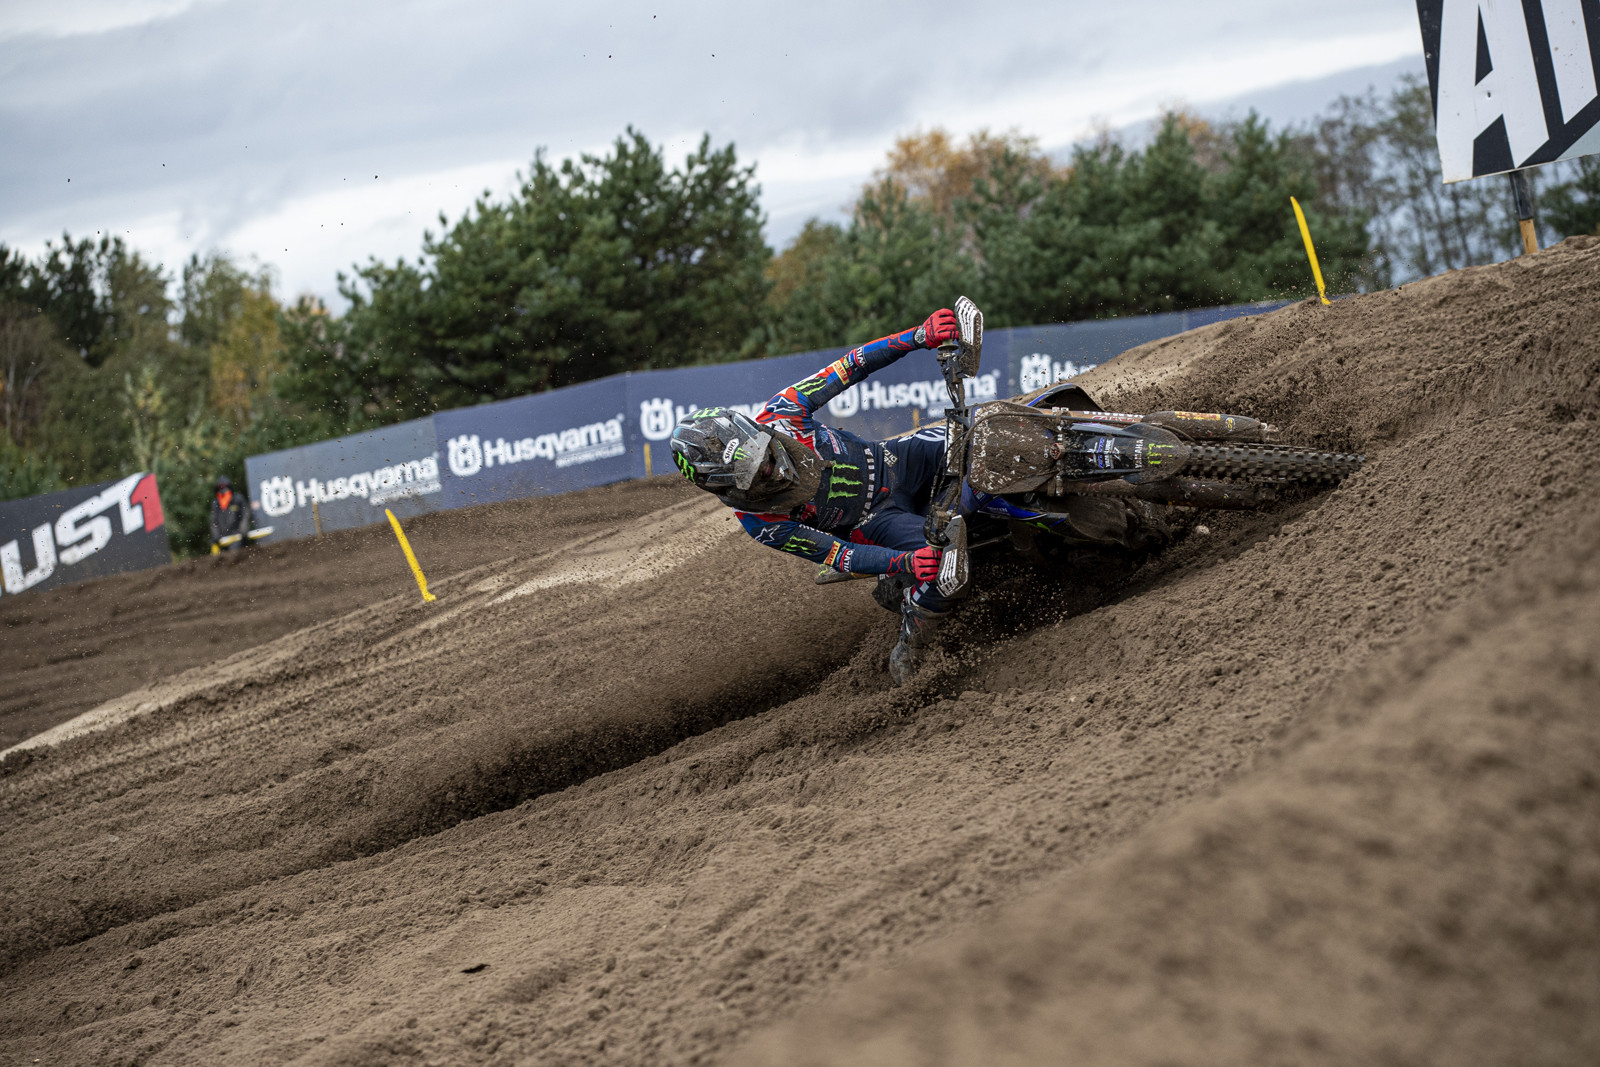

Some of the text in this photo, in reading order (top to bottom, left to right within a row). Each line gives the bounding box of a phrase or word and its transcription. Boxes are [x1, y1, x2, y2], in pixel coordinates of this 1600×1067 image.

[861, 374, 997, 411] Husqvana
[483, 419, 623, 468] Husqvarna
[1134, 439, 1144, 468] YAMAHA
[296, 457, 439, 507] Husqvarna
[0, 471, 165, 597] UST1
